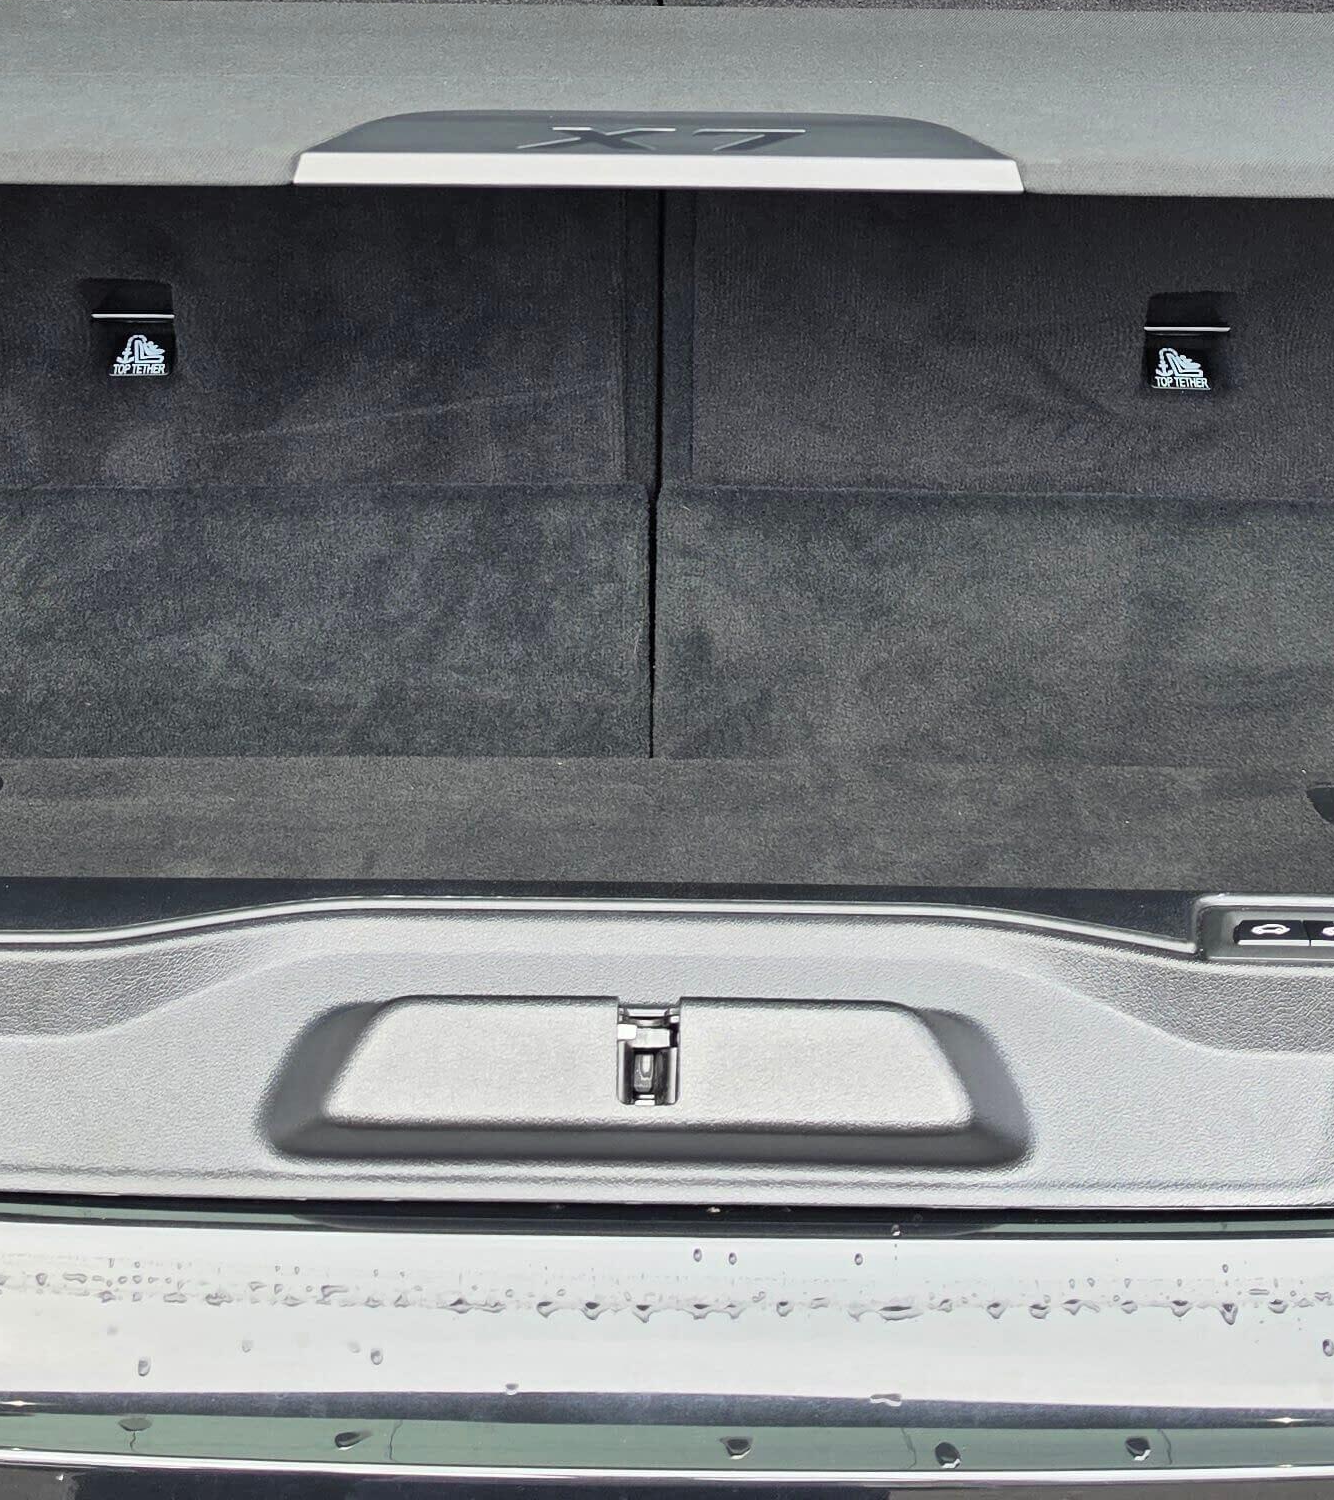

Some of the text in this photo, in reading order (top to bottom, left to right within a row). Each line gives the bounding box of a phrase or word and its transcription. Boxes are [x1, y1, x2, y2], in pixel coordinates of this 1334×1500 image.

[517, 126, 806, 151] X7
[113, 363, 165, 375] TOP TETHER
[1155, 376, 1210, 388] TOP TETHER
